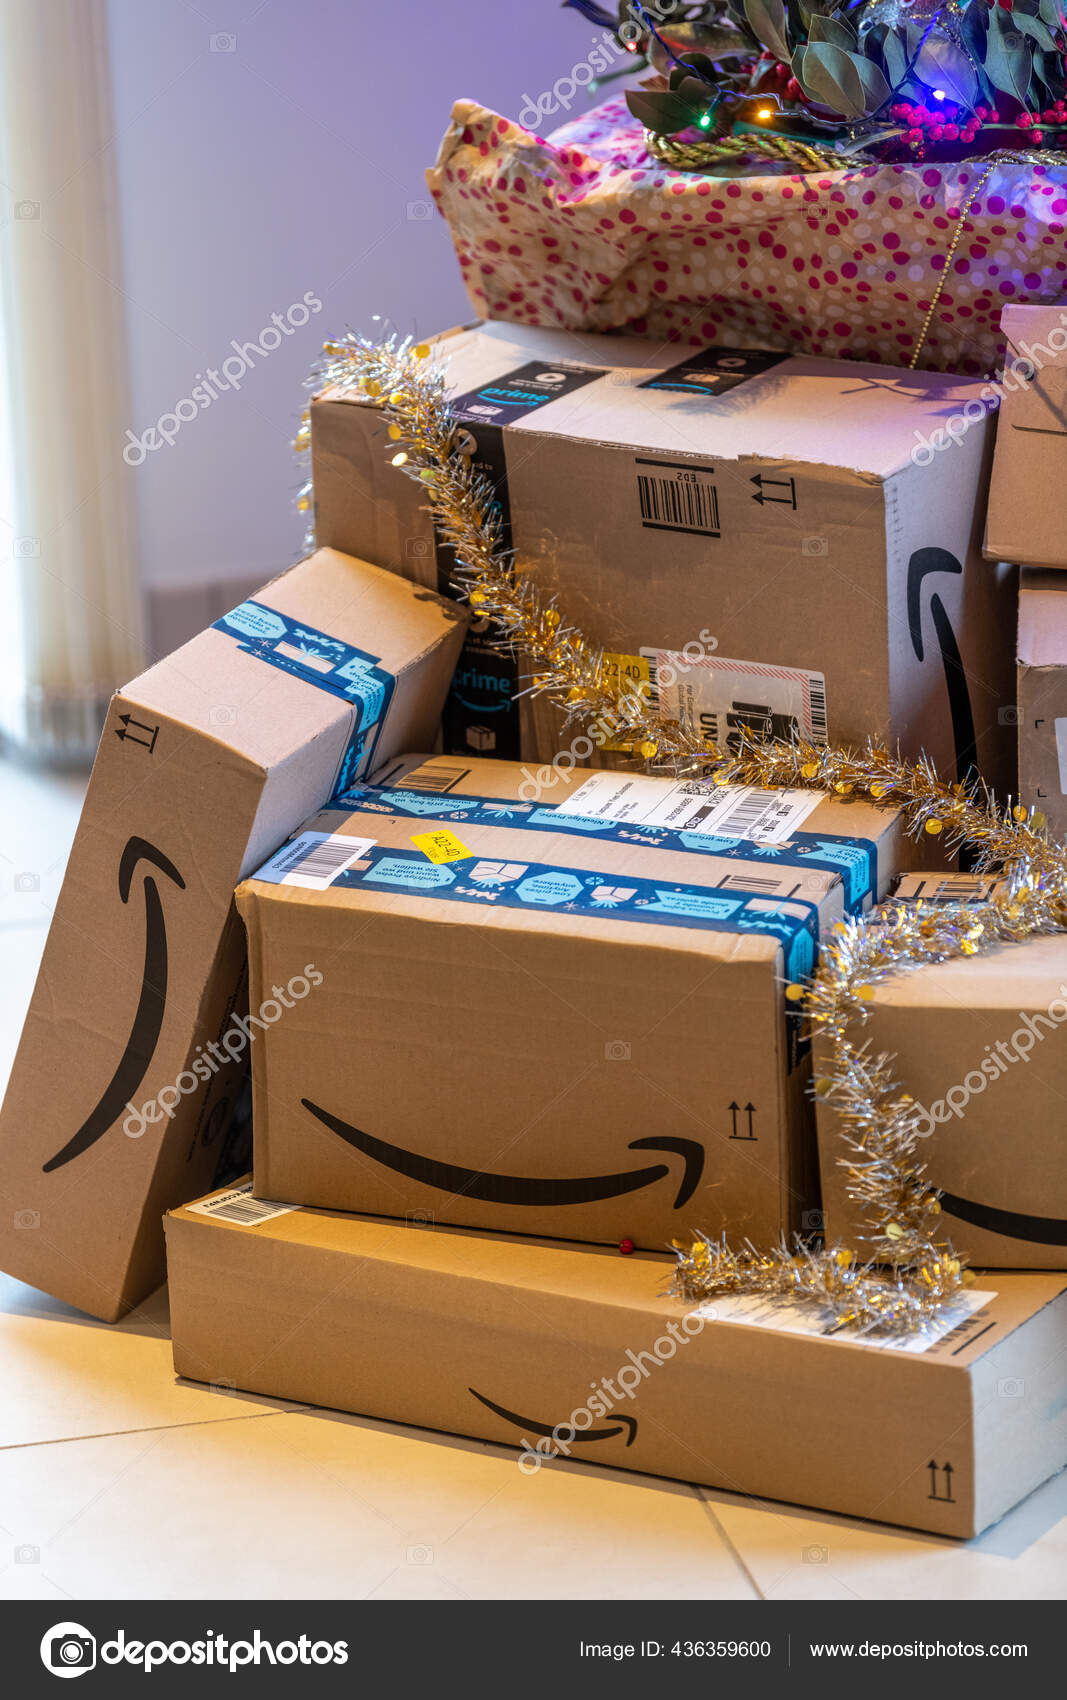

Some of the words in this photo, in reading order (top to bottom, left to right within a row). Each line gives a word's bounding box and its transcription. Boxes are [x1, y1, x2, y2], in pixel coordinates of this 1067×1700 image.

[479, 387, 550, 401] prime
[604, 662, 640, 678] 22-4D
[699, 712, 718, 741] UN
